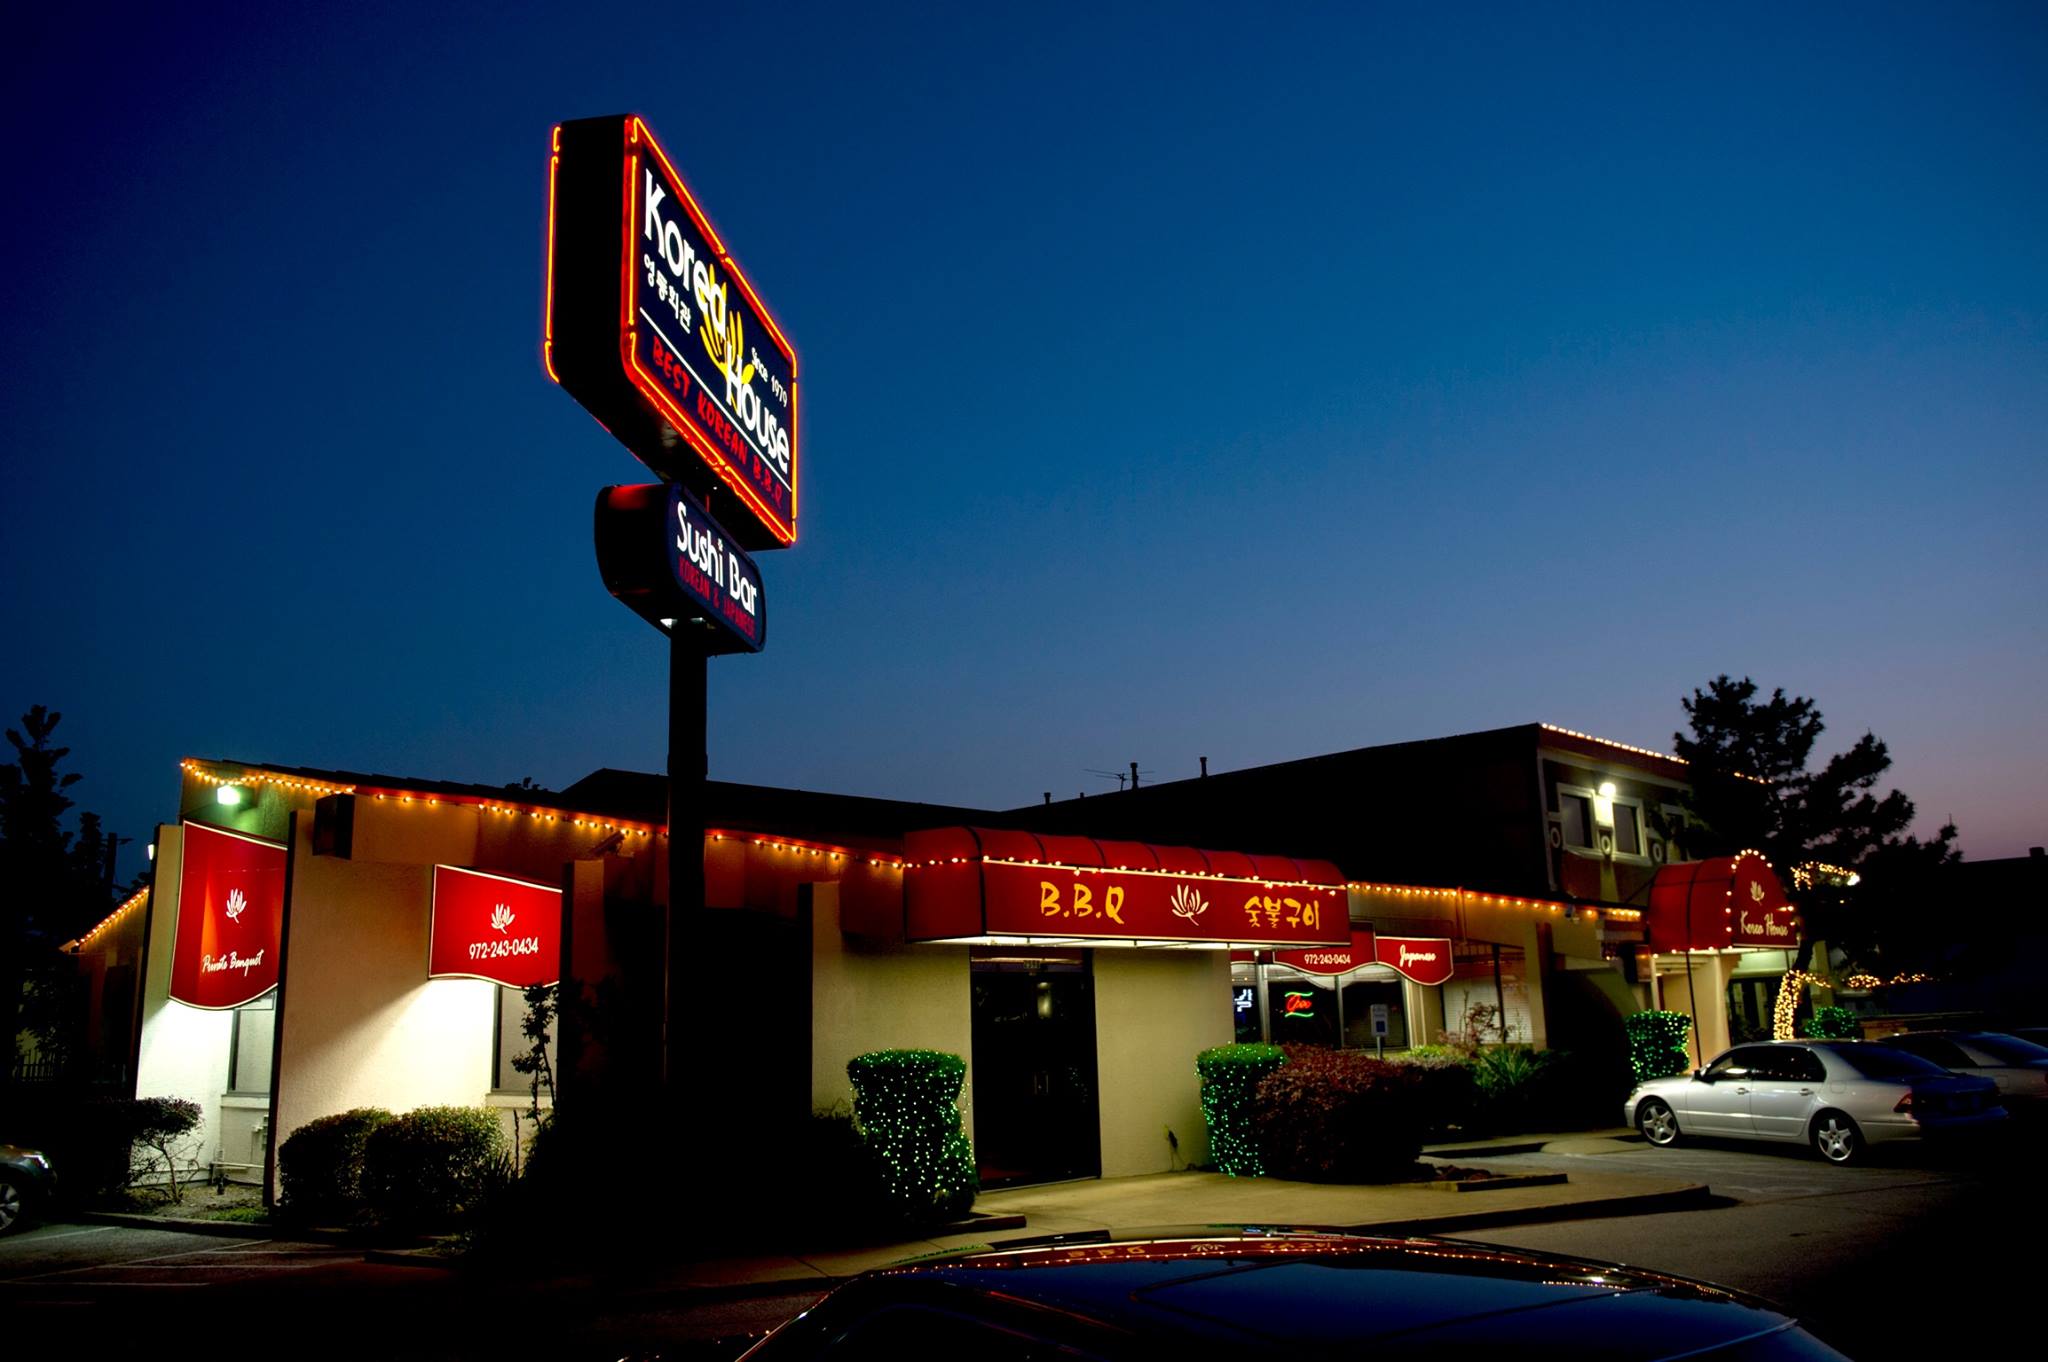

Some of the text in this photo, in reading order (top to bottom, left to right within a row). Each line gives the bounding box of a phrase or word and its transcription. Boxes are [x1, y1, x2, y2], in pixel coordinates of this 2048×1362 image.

[645, 168, 727, 341] Korea
[643, 253, 691, 334] 영동회관
[653, 335, 690, 399] BEST
[697, 389, 749, 465] KOREAN
[726, 341, 790, 475] House
[771, 375, 787, 407] 1979
[677, 501, 757, 616] Sushi Bar
[1040, 881, 1125, 925] B.B.Q
[1244, 895, 1320, 930] 숯불구이
[202, 949, 264, 977] Private Banquet
[469, 936, 539, 960] 972-243-0434
[1304, 953, 1351, 965] 972-243-0434
[1400, 944, 1437, 968] Japanese
